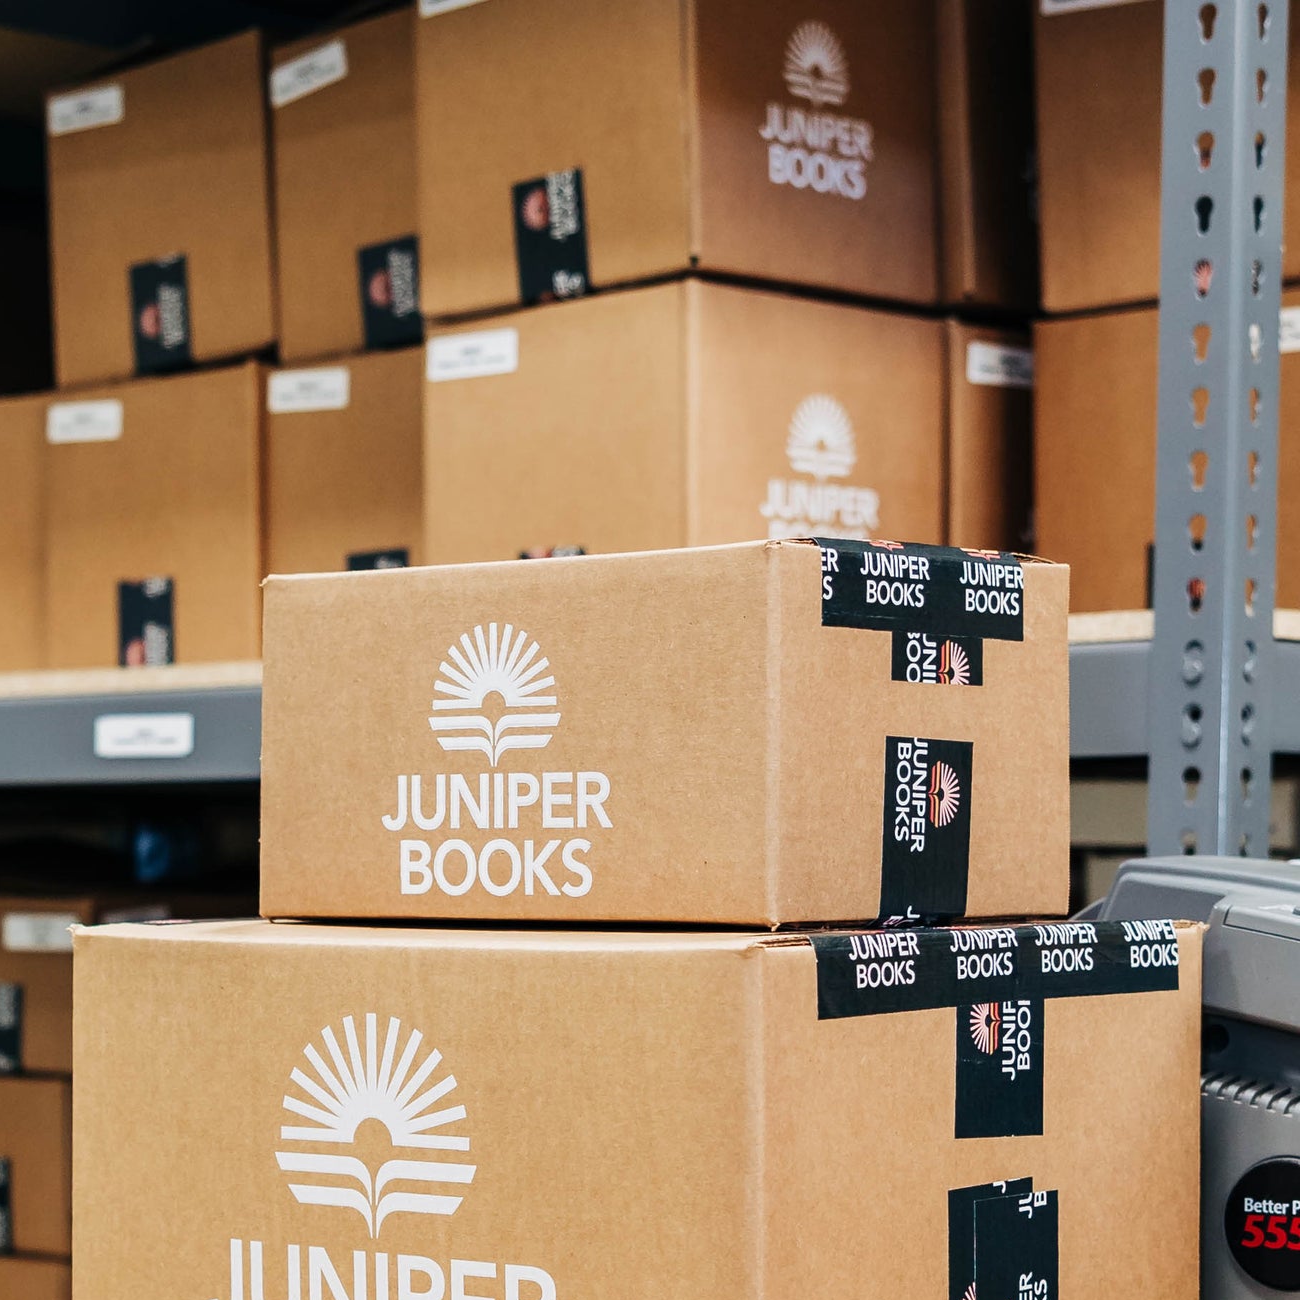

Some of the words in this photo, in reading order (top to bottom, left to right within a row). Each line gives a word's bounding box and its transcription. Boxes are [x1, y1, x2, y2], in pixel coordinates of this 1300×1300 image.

[860, 551, 930, 581] JUNIPER
[959, 561, 1024, 589] JUNIPER
[866, 580, 925, 608] BOOKS
[965, 589, 1020, 616] BOOKS
[381, 771, 614, 831] JUNIPER
[894, 741, 913, 842] BOOKS
[910, 737, 929, 853] JUNIPER
[400, 838, 593, 898] BOOKS
[848, 931, 921, 961] JUNIPER
[950, 927, 1019, 953] JUNIPER
[1034, 923, 1099, 946] JUNIPER
[956, 951, 1014, 980] BOOKS
[1041, 947, 1095, 973] BOOKS
[1130, 943, 1179, 968] BOOKS
[855, 960, 916, 989] BOOKS
[1244, 1197, 1289, 1215] Better
